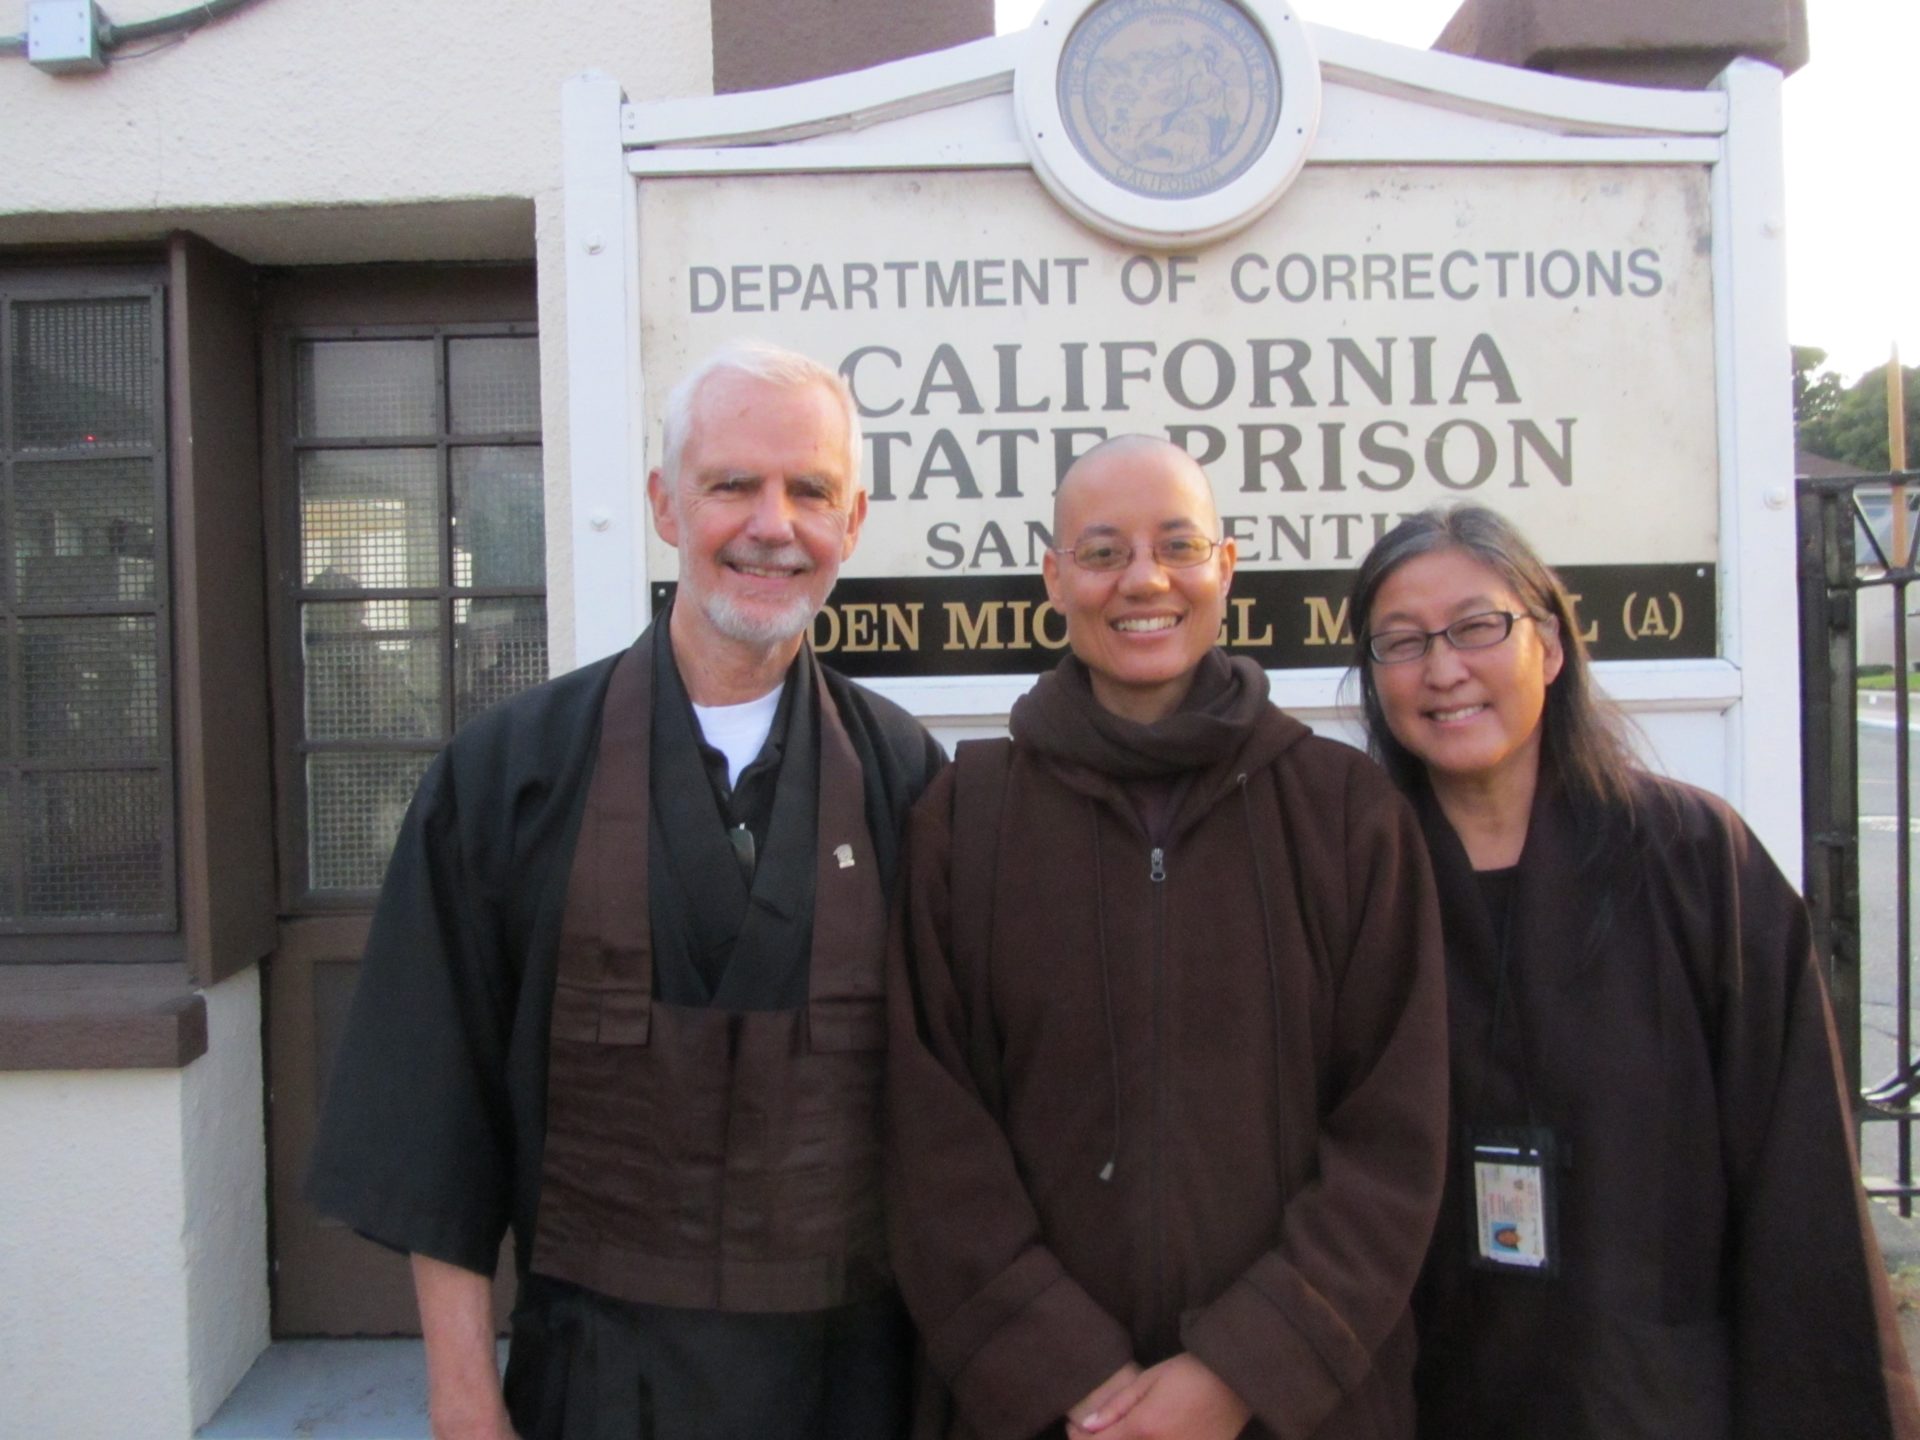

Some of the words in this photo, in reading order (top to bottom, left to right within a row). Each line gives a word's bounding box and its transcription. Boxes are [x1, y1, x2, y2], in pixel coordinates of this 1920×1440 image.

[690, 257, 1089, 313] DEPARTMENT
[1120, 255, 1199, 305] OF
[1230, 248, 1663, 302] CORRECTIONS
[838, 333, 1522, 418] CALIFORNIA
[862, 427, 1108, 501] TATE
[1164, 417, 1578, 493] PRISON
[925, 520, 1054, 570] SAN
[806, 602, 924, 652] DEN
[1622, 591, 1684, 641] (A)
